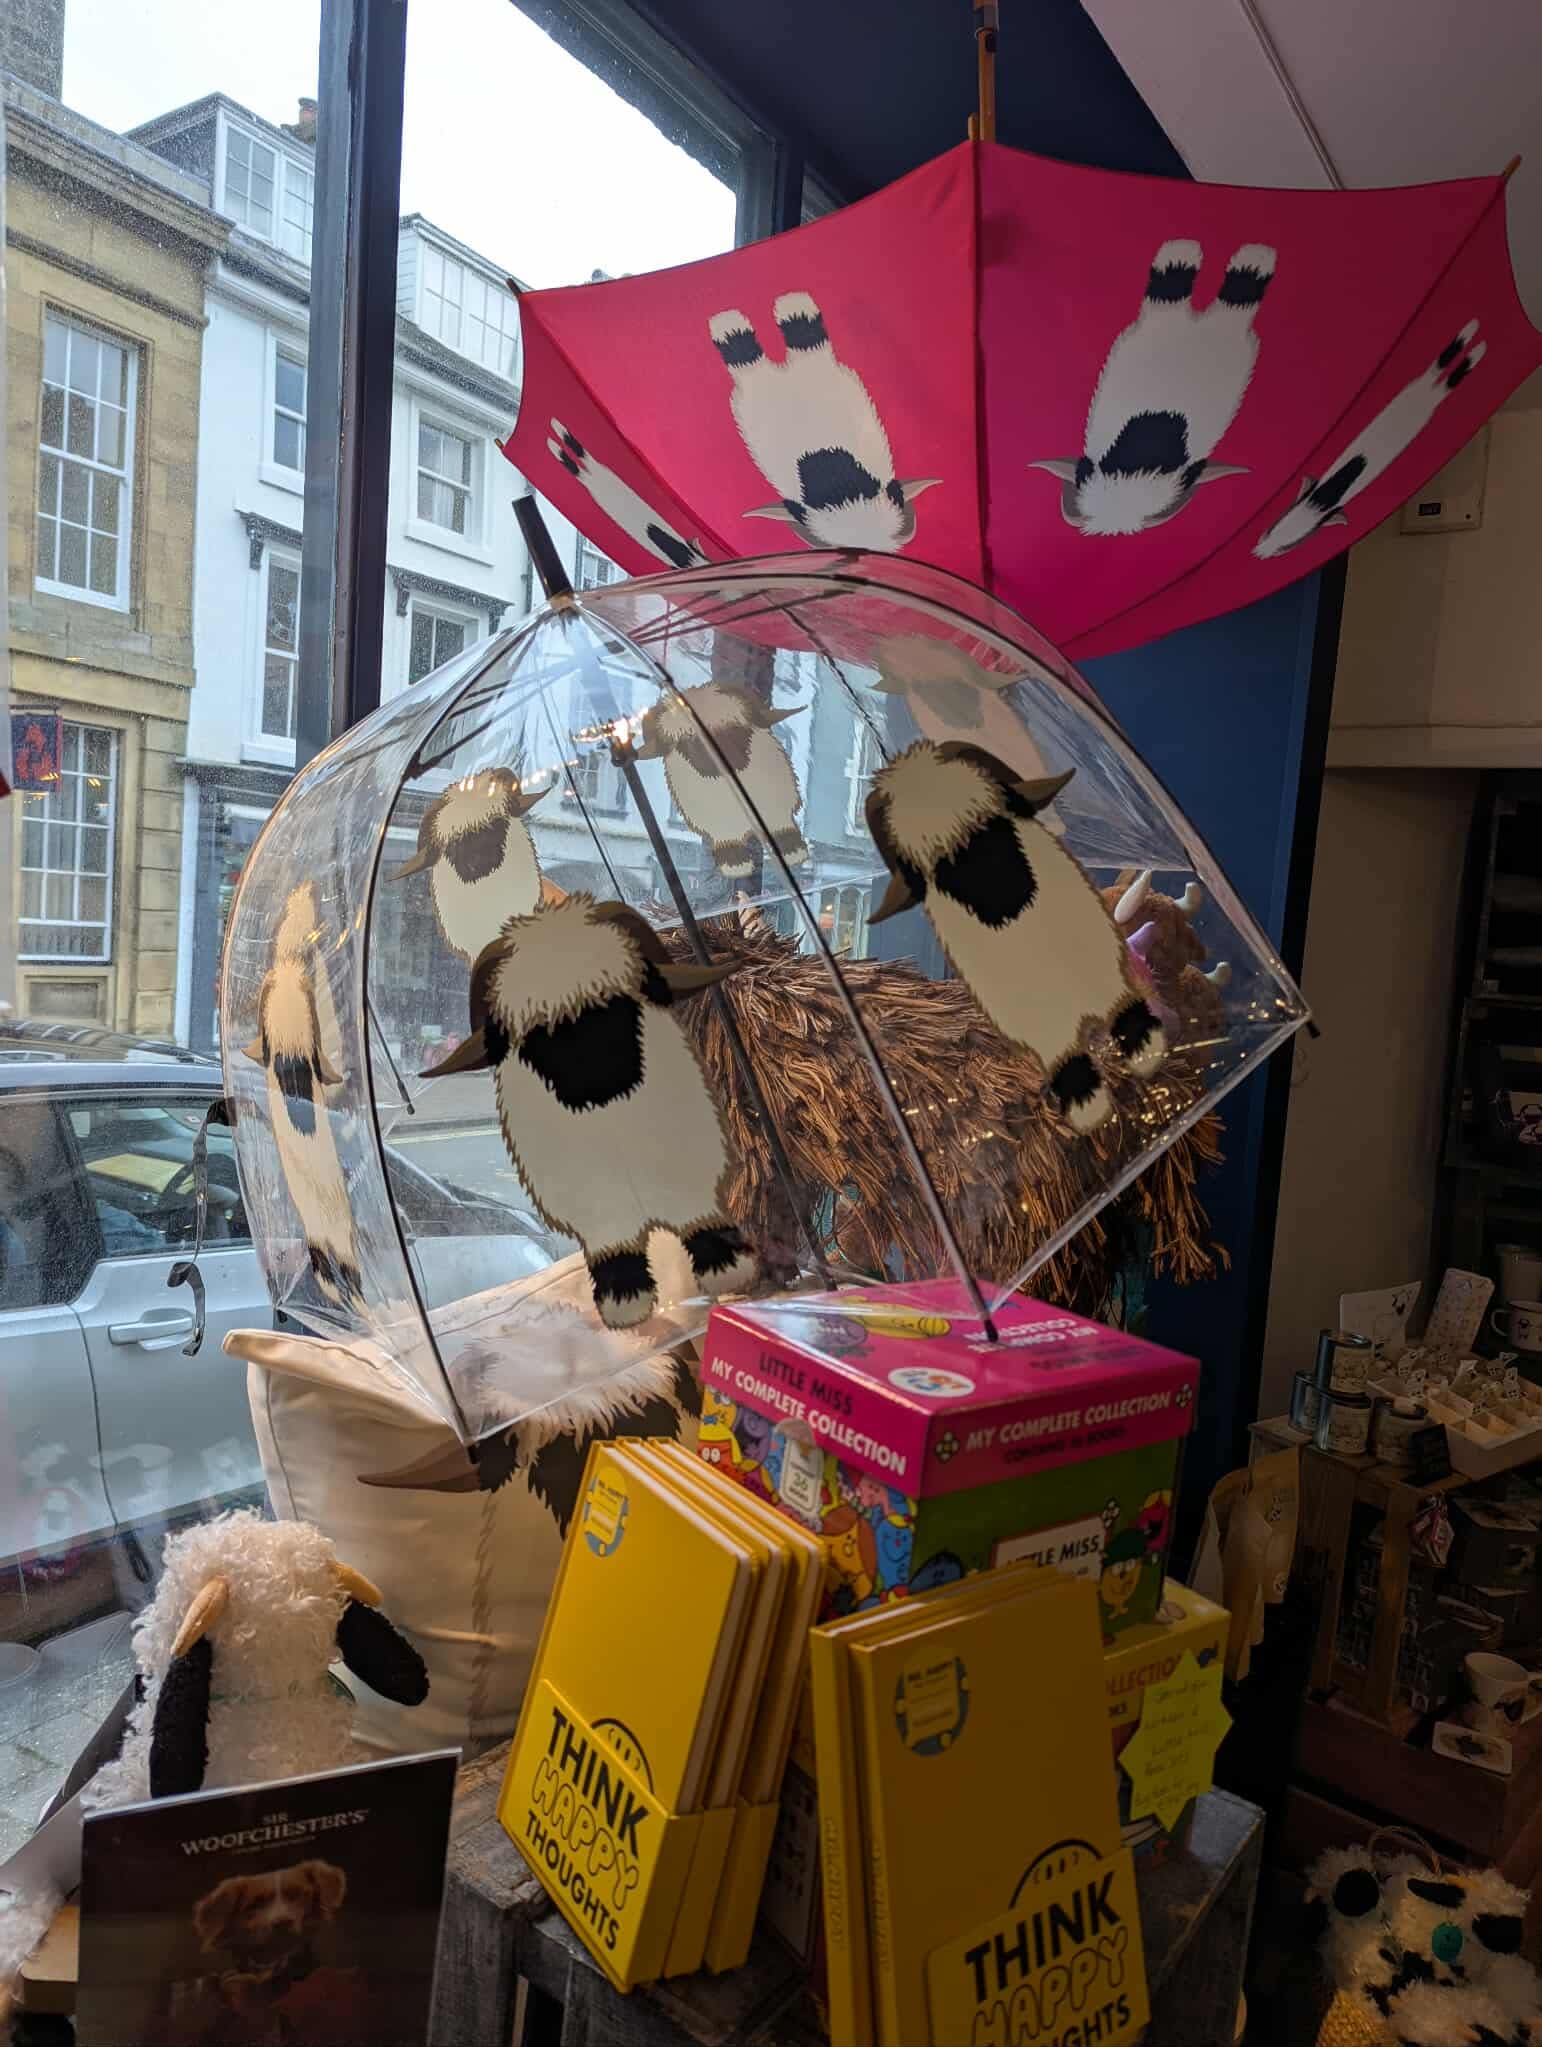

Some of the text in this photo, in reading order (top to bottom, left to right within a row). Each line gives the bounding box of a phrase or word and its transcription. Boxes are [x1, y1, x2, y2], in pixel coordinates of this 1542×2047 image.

[711, 1356, 906, 1476] MY COMPLETE COLLECTION
[759, 1351, 804, 1391] LITTLE
[809, 1378, 854, 1415] MISS
[965, 1391, 1172, 1450] MY COMPLETE COLLECTION
[1059, 1534, 1100, 1564] MISS
[180, 1809, 369, 1857] WOOFCHESTER'S
[261, 1812, 289, 1826] SIR
[532, 1757, 639, 1911] HAPPY
[547, 1706, 649, 1859] THINK
[525, 1810, 620, 1951] THOUGHTS
[965, 1870, 1121, 2005] THINK
[971, 1925, 1129, 2047] HAPPY
